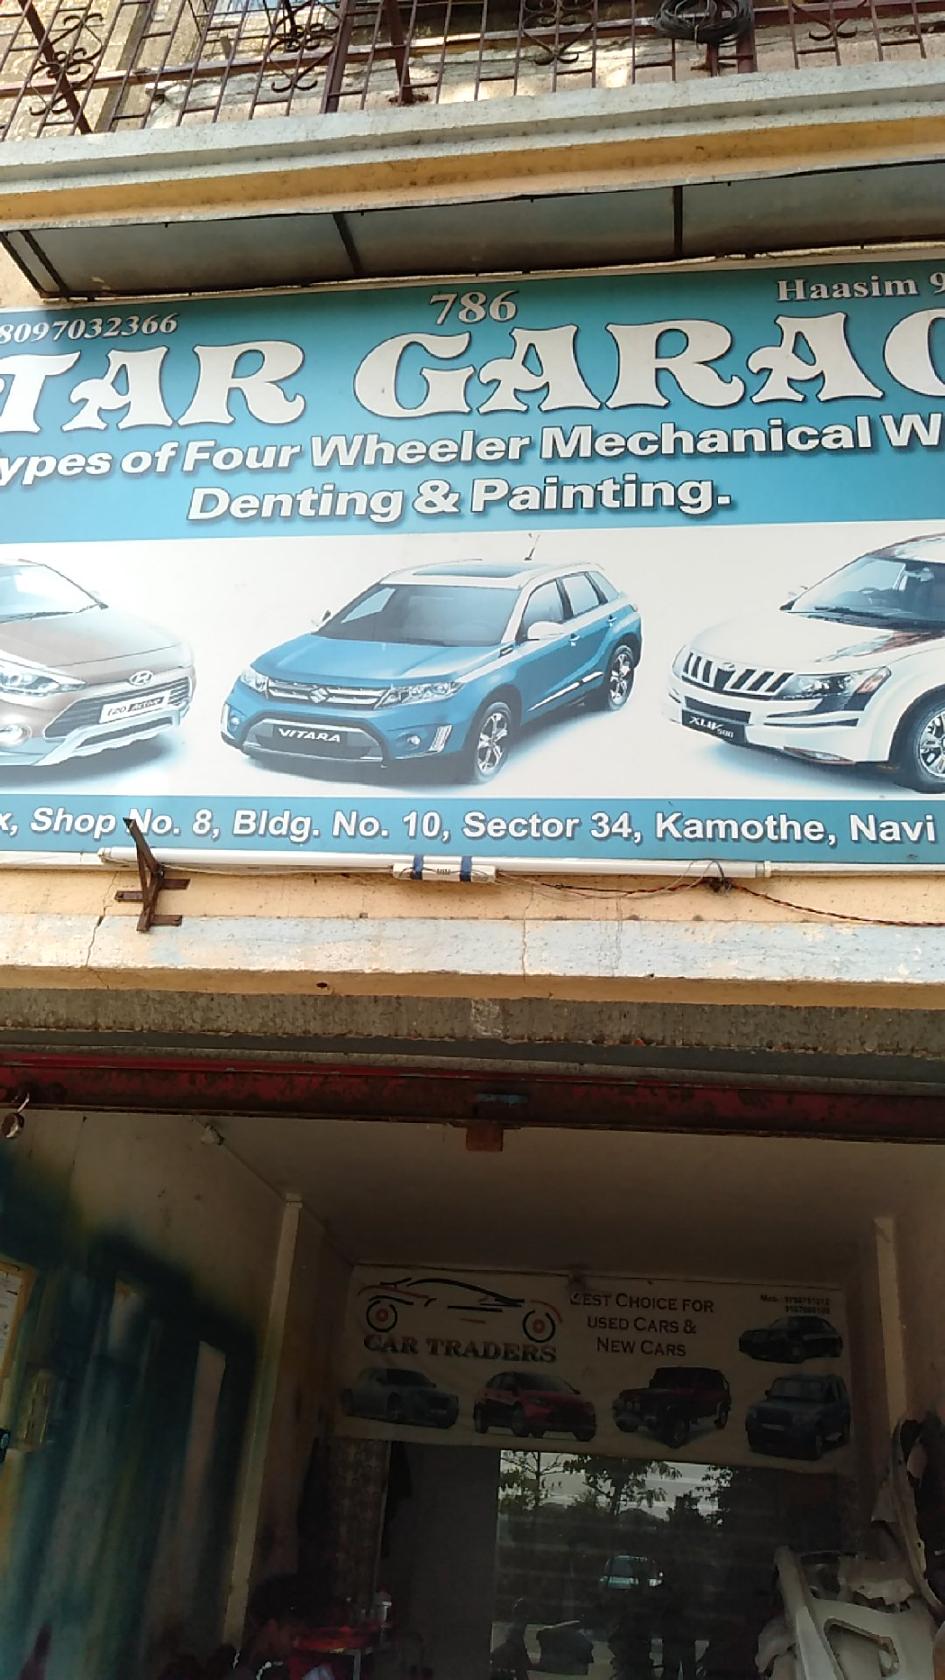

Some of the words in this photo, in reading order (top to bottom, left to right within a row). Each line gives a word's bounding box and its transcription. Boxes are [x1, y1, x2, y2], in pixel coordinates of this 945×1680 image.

[777, 274, 919, 301] Haasim
[429, 290, 518, 325] 786
[0, 313, 178, 344] 8097032366
[0, 340, 305, 433] TAR
[121, 440, 179, 475] of
[182, 439, 302, 473] Four
[310, 429, 532, 468] Wheeler
[540, 415, 872, 460] Mechanical
[187, 483, 404, 523] Denting
[412, 479, 461, 514] &
[471, 472, 732, 516] Painting.
[278, 727, 342, 743] VITARA
[30, 807, 117, 839] Shop
[192, 810, 220, 840] 8,
[233, 809, 320, 842] Bldg.
[332, 811, 390, 838] No.
[403, 812, 450, 842] 10,
[463, 811, 579, 839] Sector
[590, 812, 642, 844] 34,
[656, 812, 838, 846] Kamothe,
[850, 813, 936, 842] Navi
[683, 1319, 697, 1334] &
[363, 1334, 418, 1355] CAR
[426, 1338, 557, 1363] TRADERS
